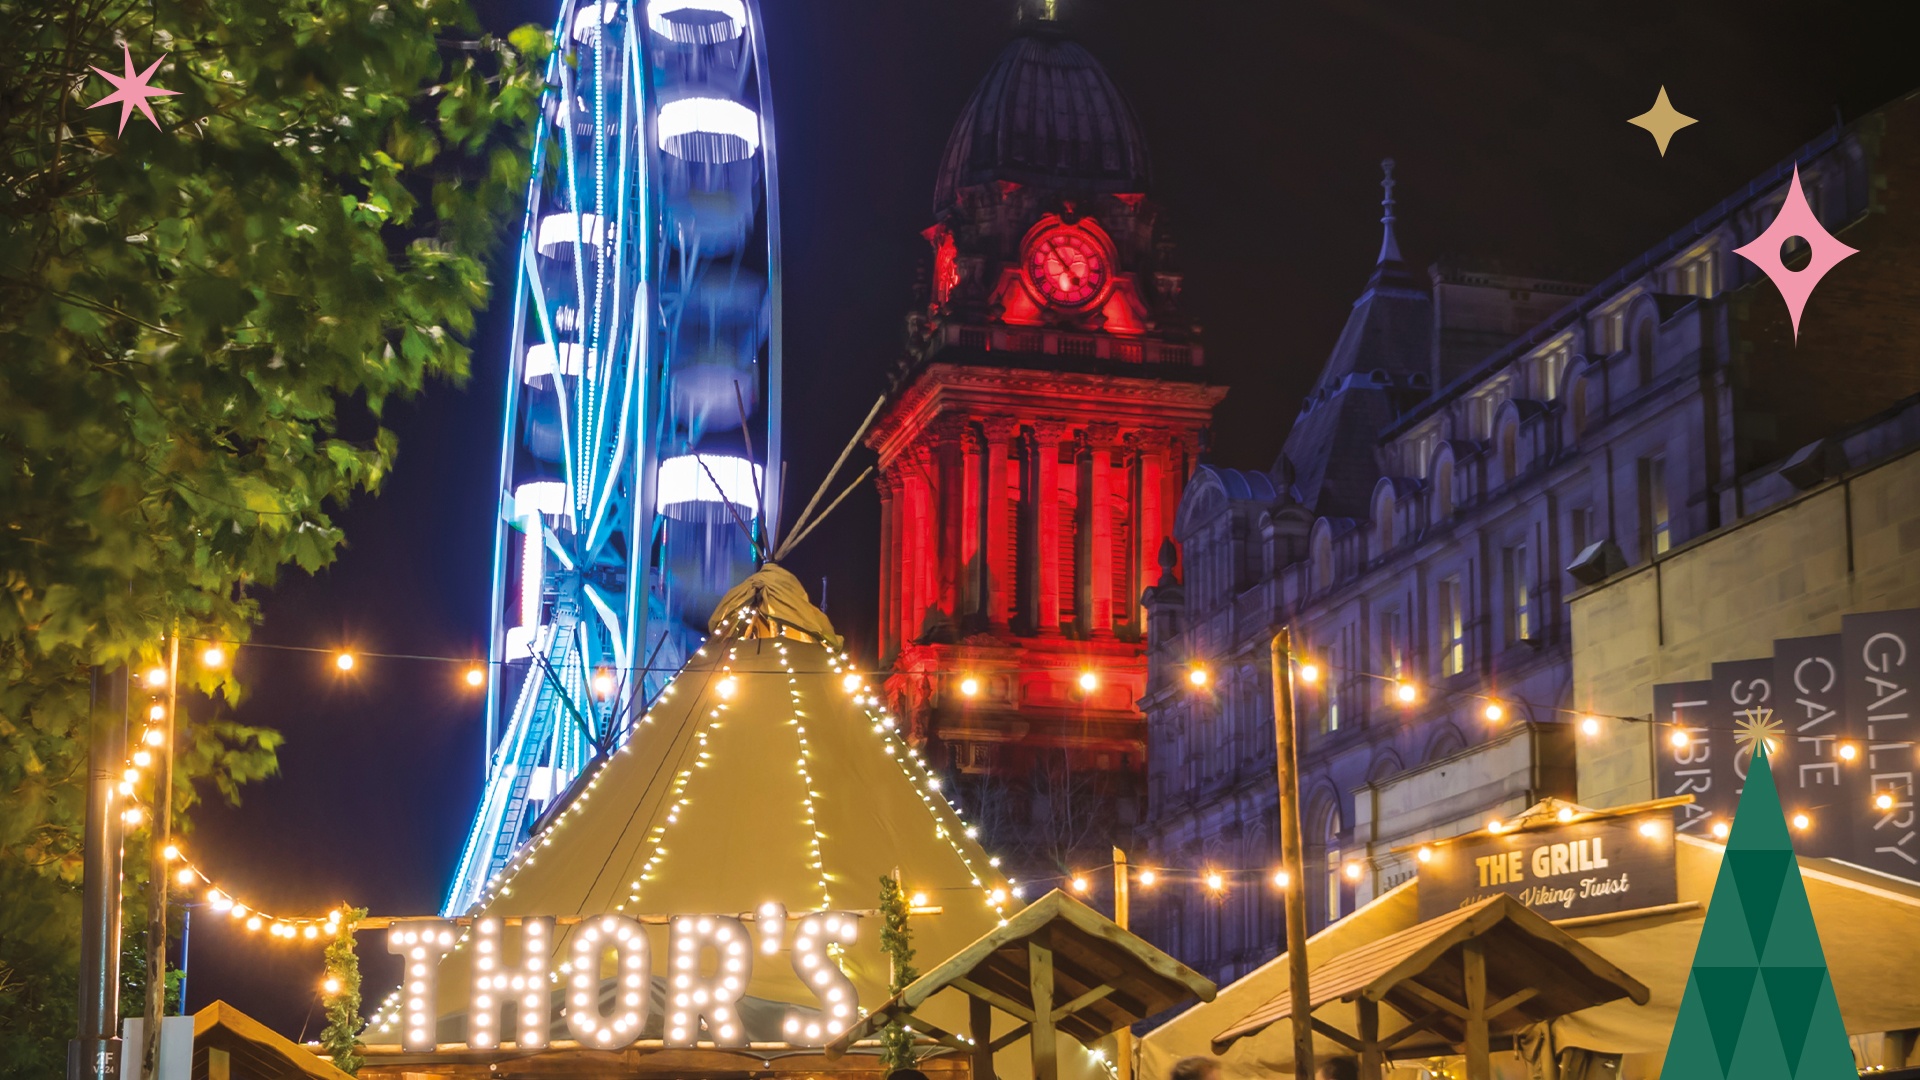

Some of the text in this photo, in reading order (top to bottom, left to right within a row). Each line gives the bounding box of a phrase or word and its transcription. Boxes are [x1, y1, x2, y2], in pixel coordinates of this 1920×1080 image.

[1672, 700, 1712, 834] LIBRA
[1793, 657, 1840, 788] CAFE
[1862, 632, 1918, 865] GALLERY
[1476, 837, 1608, 887] THE GRILL
[1519, 885, 1576, 908] Viking
[1579, 873, 1630, 900] Twist
[387, 902, 859, 1052] THOR'S
